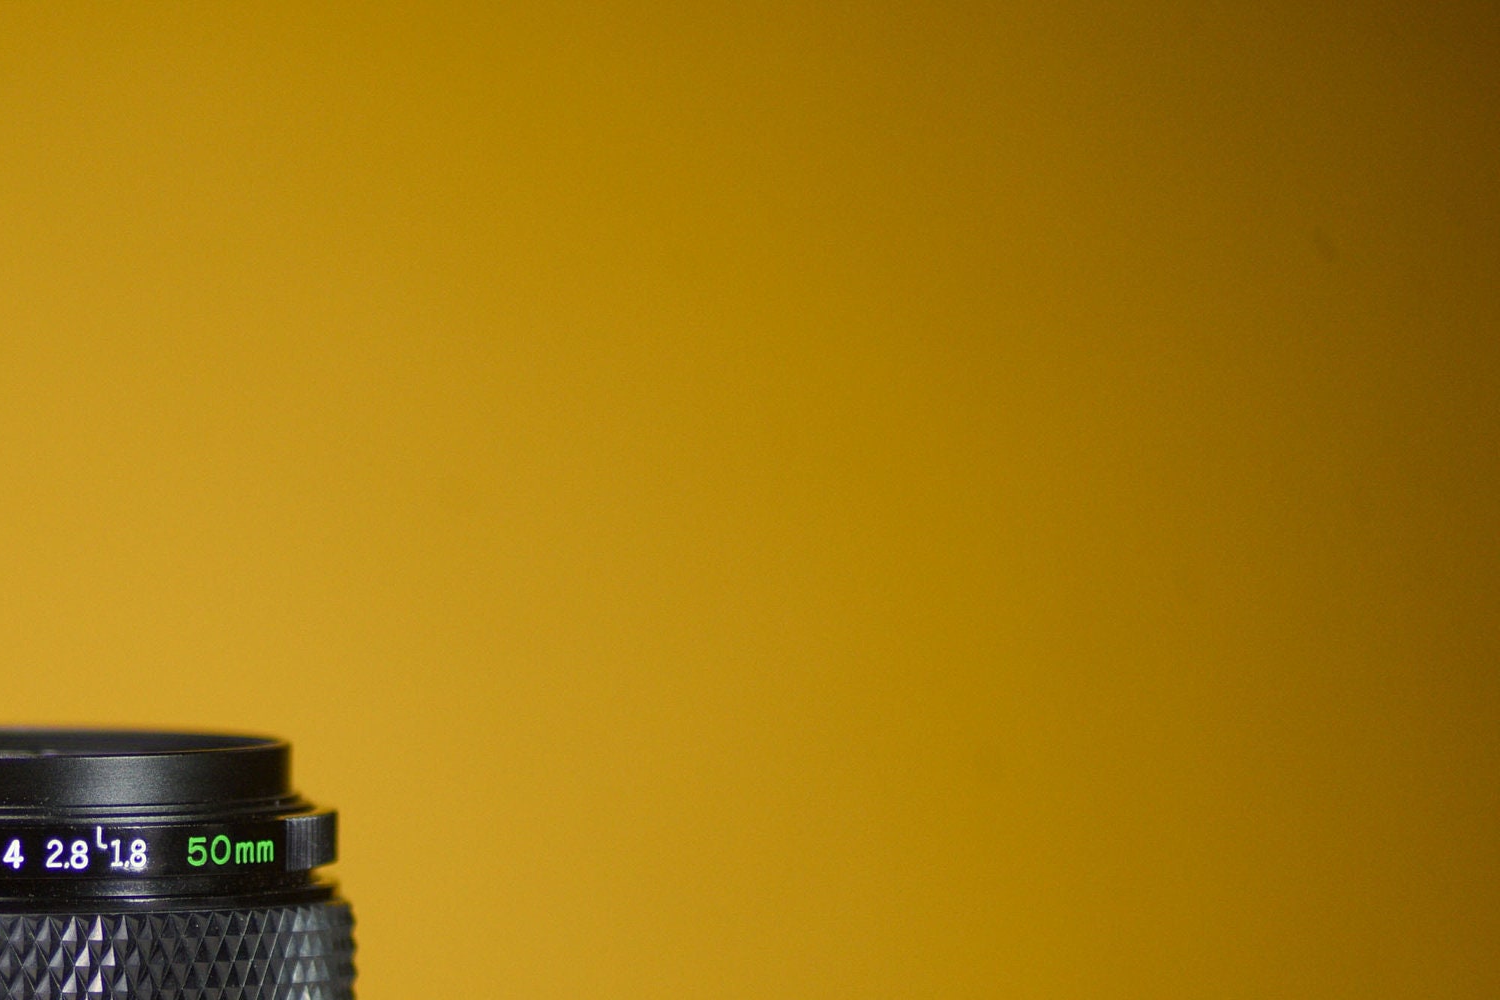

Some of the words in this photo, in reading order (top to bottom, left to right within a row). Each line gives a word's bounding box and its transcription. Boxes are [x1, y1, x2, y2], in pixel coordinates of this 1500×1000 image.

[2, 839, 25, 869] 4
[45, 838, 89, 870] 2.8
[110, 838, 148, 871] 1.8
[187, 834, 274, 867] 50mm
